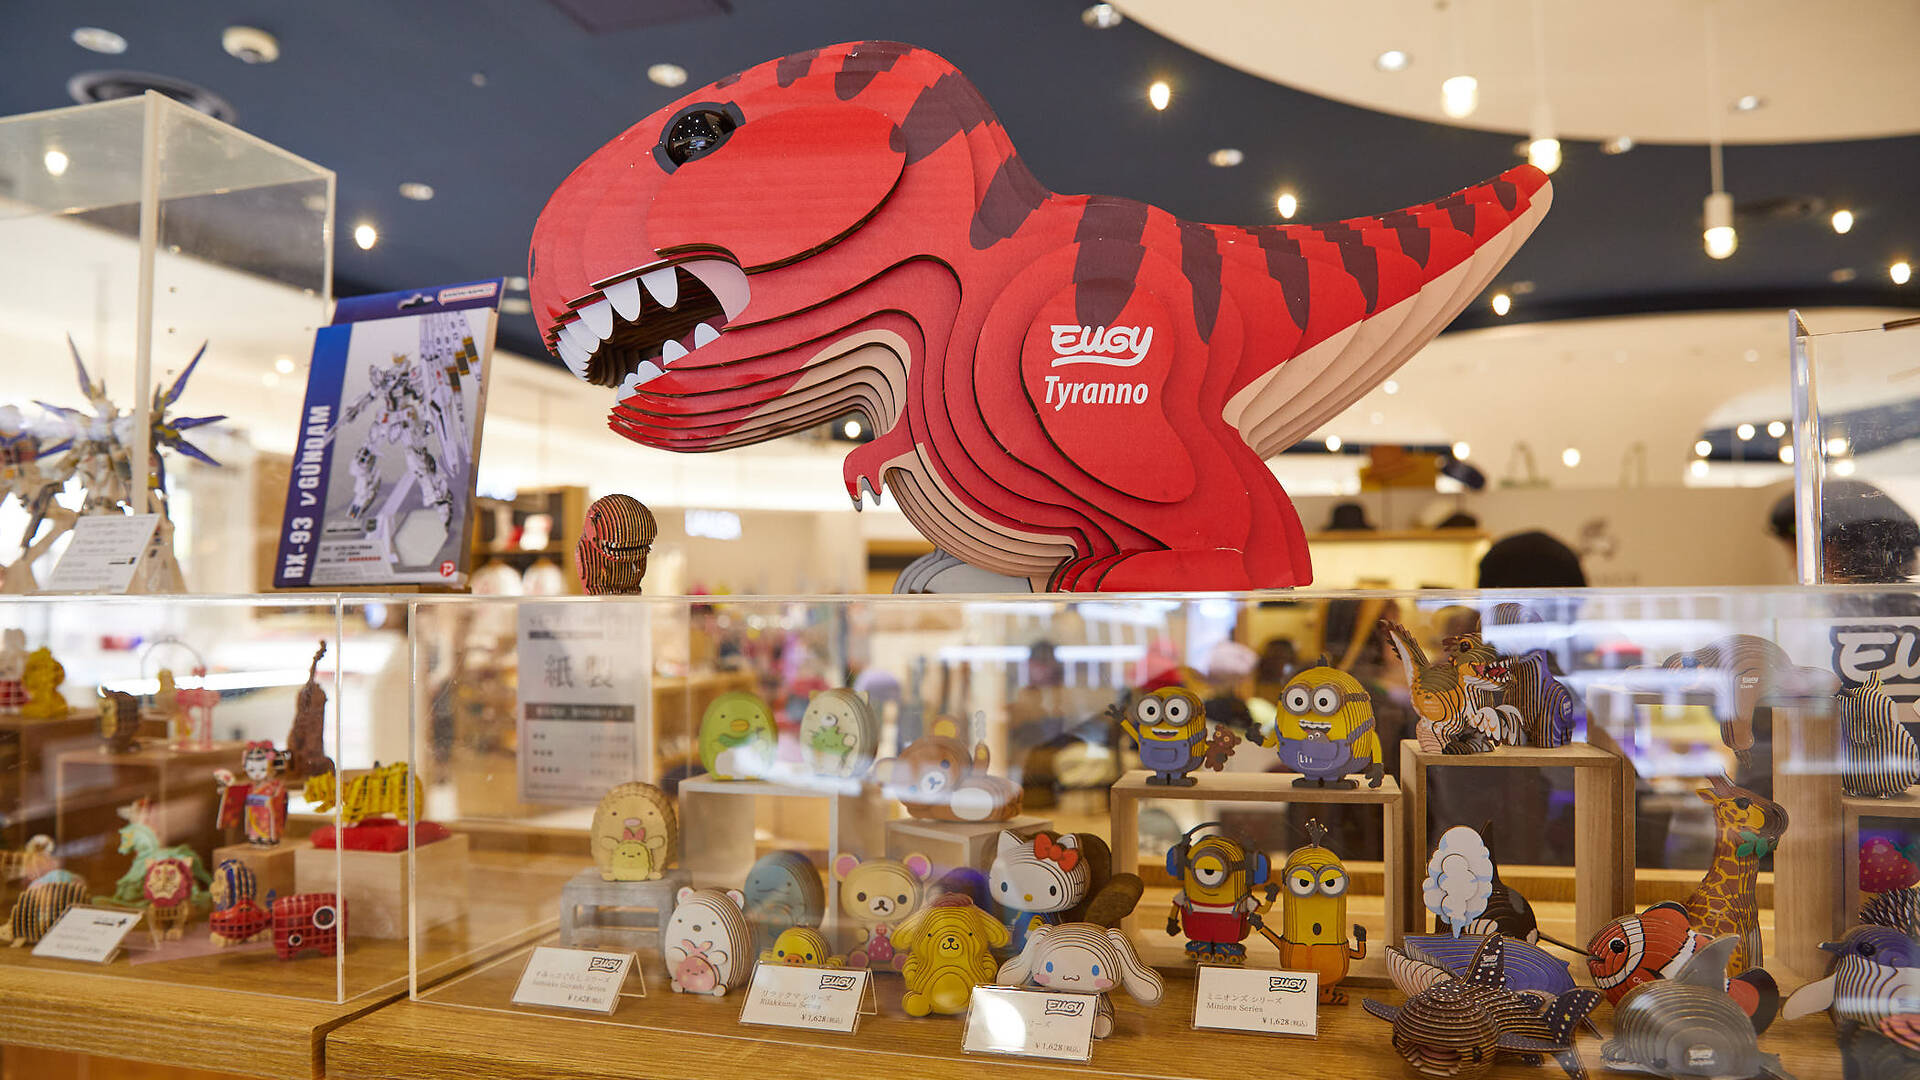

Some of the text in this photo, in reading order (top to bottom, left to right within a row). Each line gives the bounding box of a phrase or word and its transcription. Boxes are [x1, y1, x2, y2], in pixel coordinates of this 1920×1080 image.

[1050, 325, 1154, 367] EUGY
[1044, 376, 1149, 411] Tyranno
[298, 405, 331, 489] GUNDAM
[284, 517, 313, 578] RX-93
[819, 974, 857, 991] EUGY
[1269, 976, 1307, 994] EUGY
[1045, 999, 1085, 1017] EUGY
[1206, 1002, 1264, 1013] Minions Series
